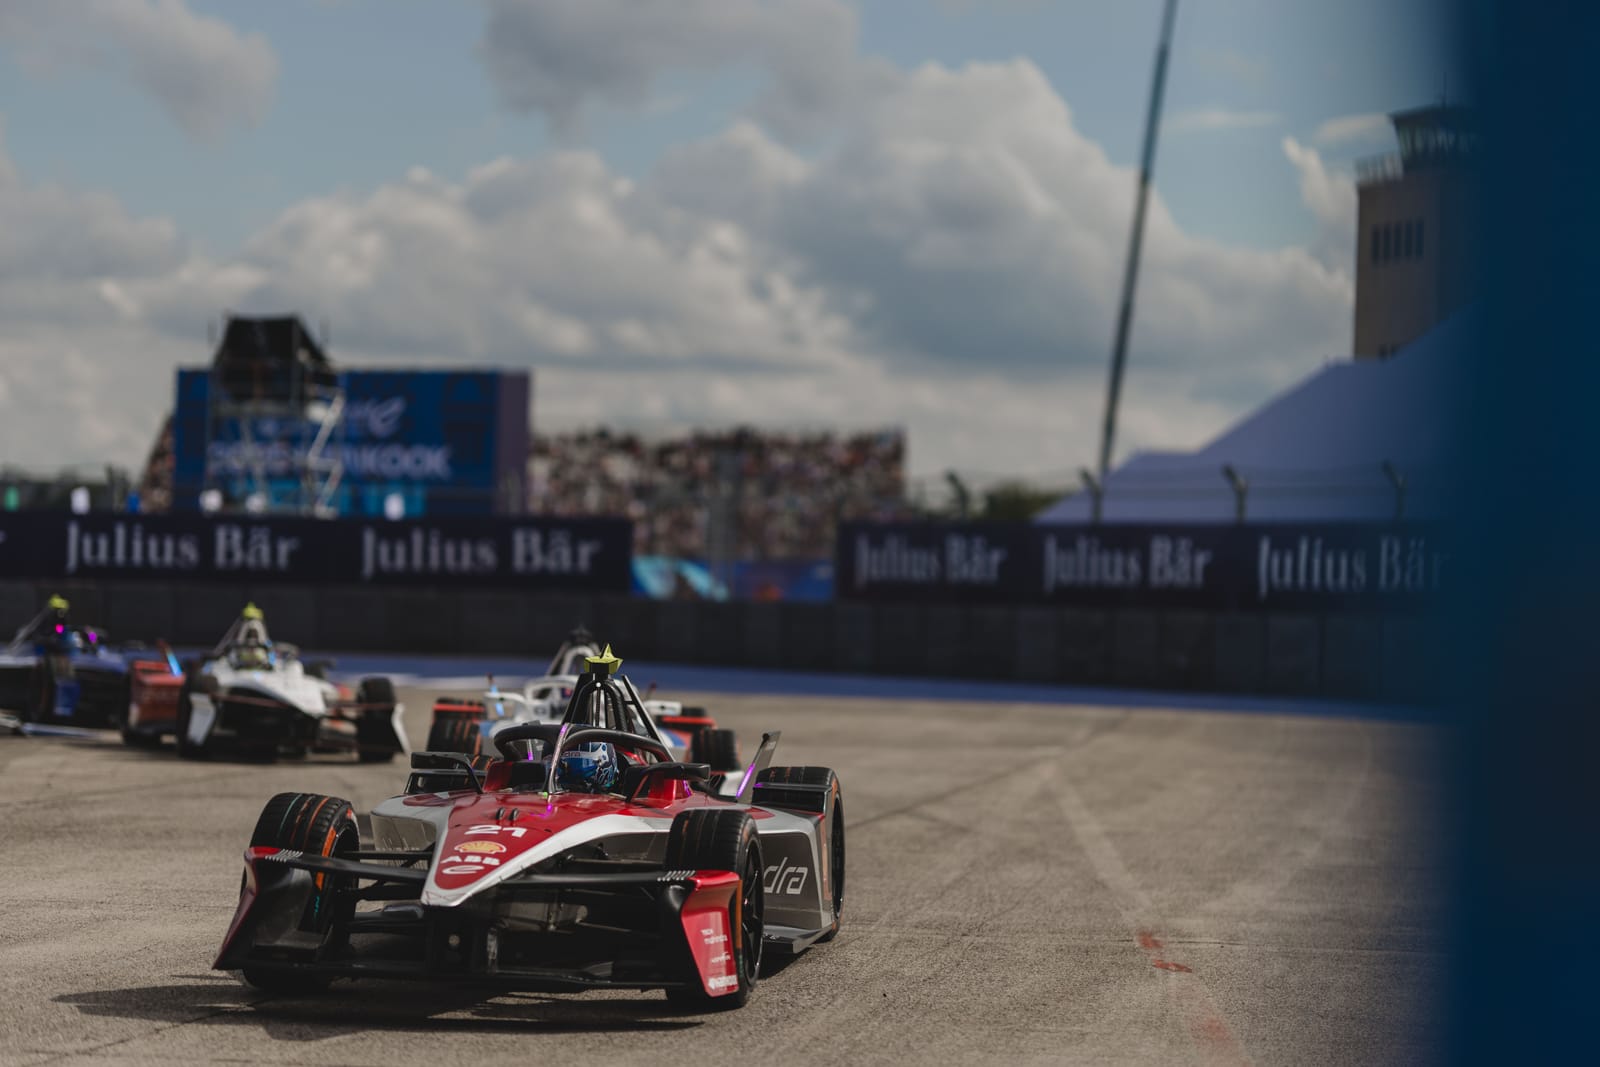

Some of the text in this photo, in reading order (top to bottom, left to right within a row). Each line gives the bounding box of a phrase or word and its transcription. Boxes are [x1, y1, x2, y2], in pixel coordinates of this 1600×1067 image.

[66, 520, 299, 573] Julius Bär
[361, 526, 600, 580] Julius Bär
[855, 533, 1005, 588] Julius Bär
[1044, 534, 1212, 591] Julius Bär
[1258, 535, 1366, 599] Julius
[464, 824, 528, 838] 21
